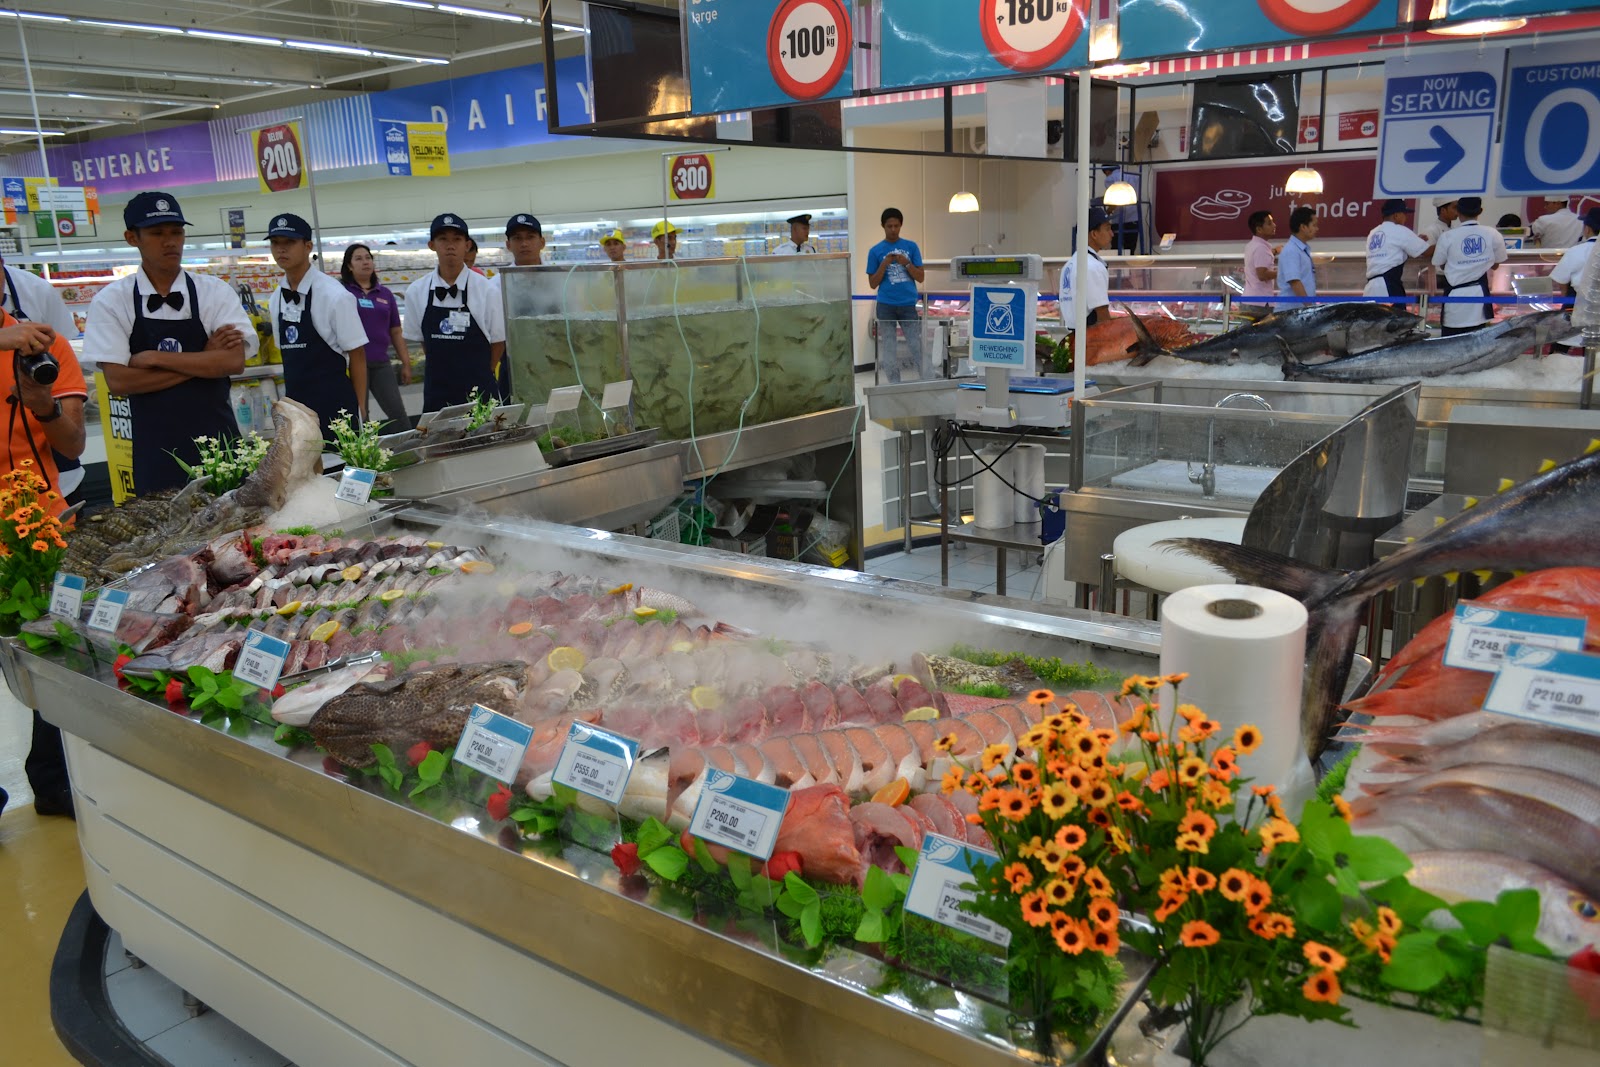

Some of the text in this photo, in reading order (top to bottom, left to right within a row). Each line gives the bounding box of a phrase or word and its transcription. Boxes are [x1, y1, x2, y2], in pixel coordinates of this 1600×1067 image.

[1056, 2, 1067, 12] kg
[691, 10, 717, 24] large
[1423, 77, 1460, 91] NOW
[1390, 88, 1491, 113] SERVING
[72, 147, 174, 182] BEVERAGE
[979, 344, 1018, 353] RE-WEIGHING
[983, 352, 1013, 360] WELCOME
[573, 762, 599, 779] P555.00
[710, 808, 739, 828] P260.00
